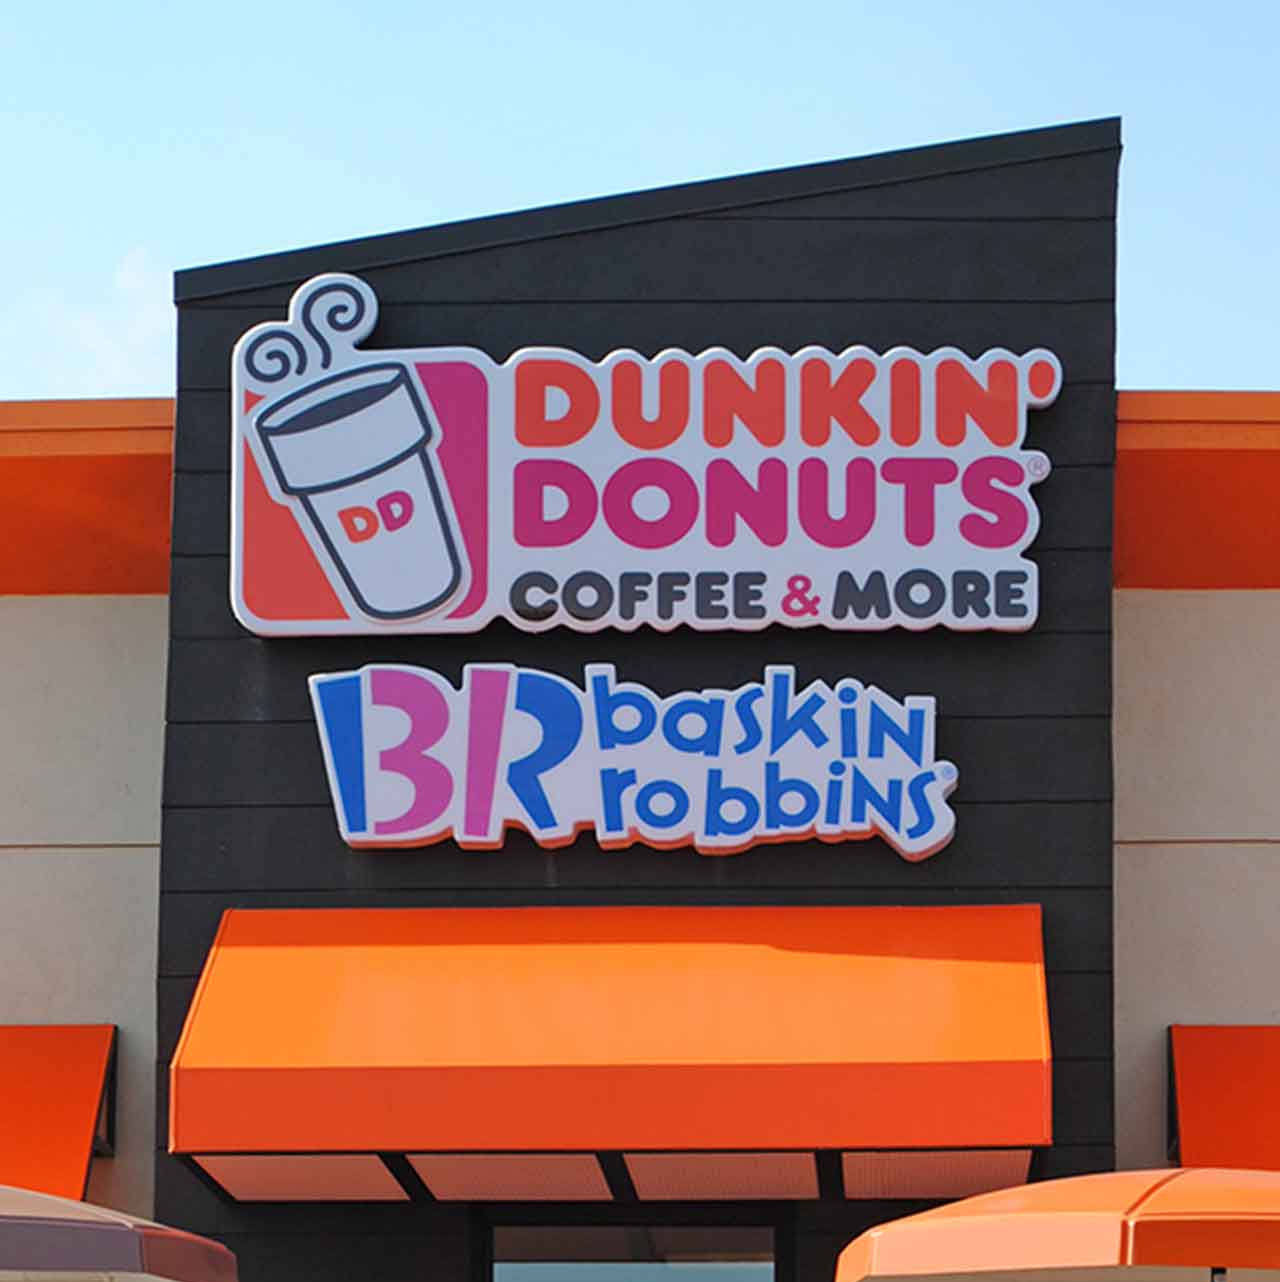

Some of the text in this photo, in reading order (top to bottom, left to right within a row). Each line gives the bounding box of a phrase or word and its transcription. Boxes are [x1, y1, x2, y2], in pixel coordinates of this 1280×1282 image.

[513, 357, 1056, 450] DUNKIN'
[337, 494, 415, 545] DD
[513, 457, 1031, 551] DONUTS
[508, 570, 1029, 622] COFFEE & MORE
[315, 669, 584, 837] BR
